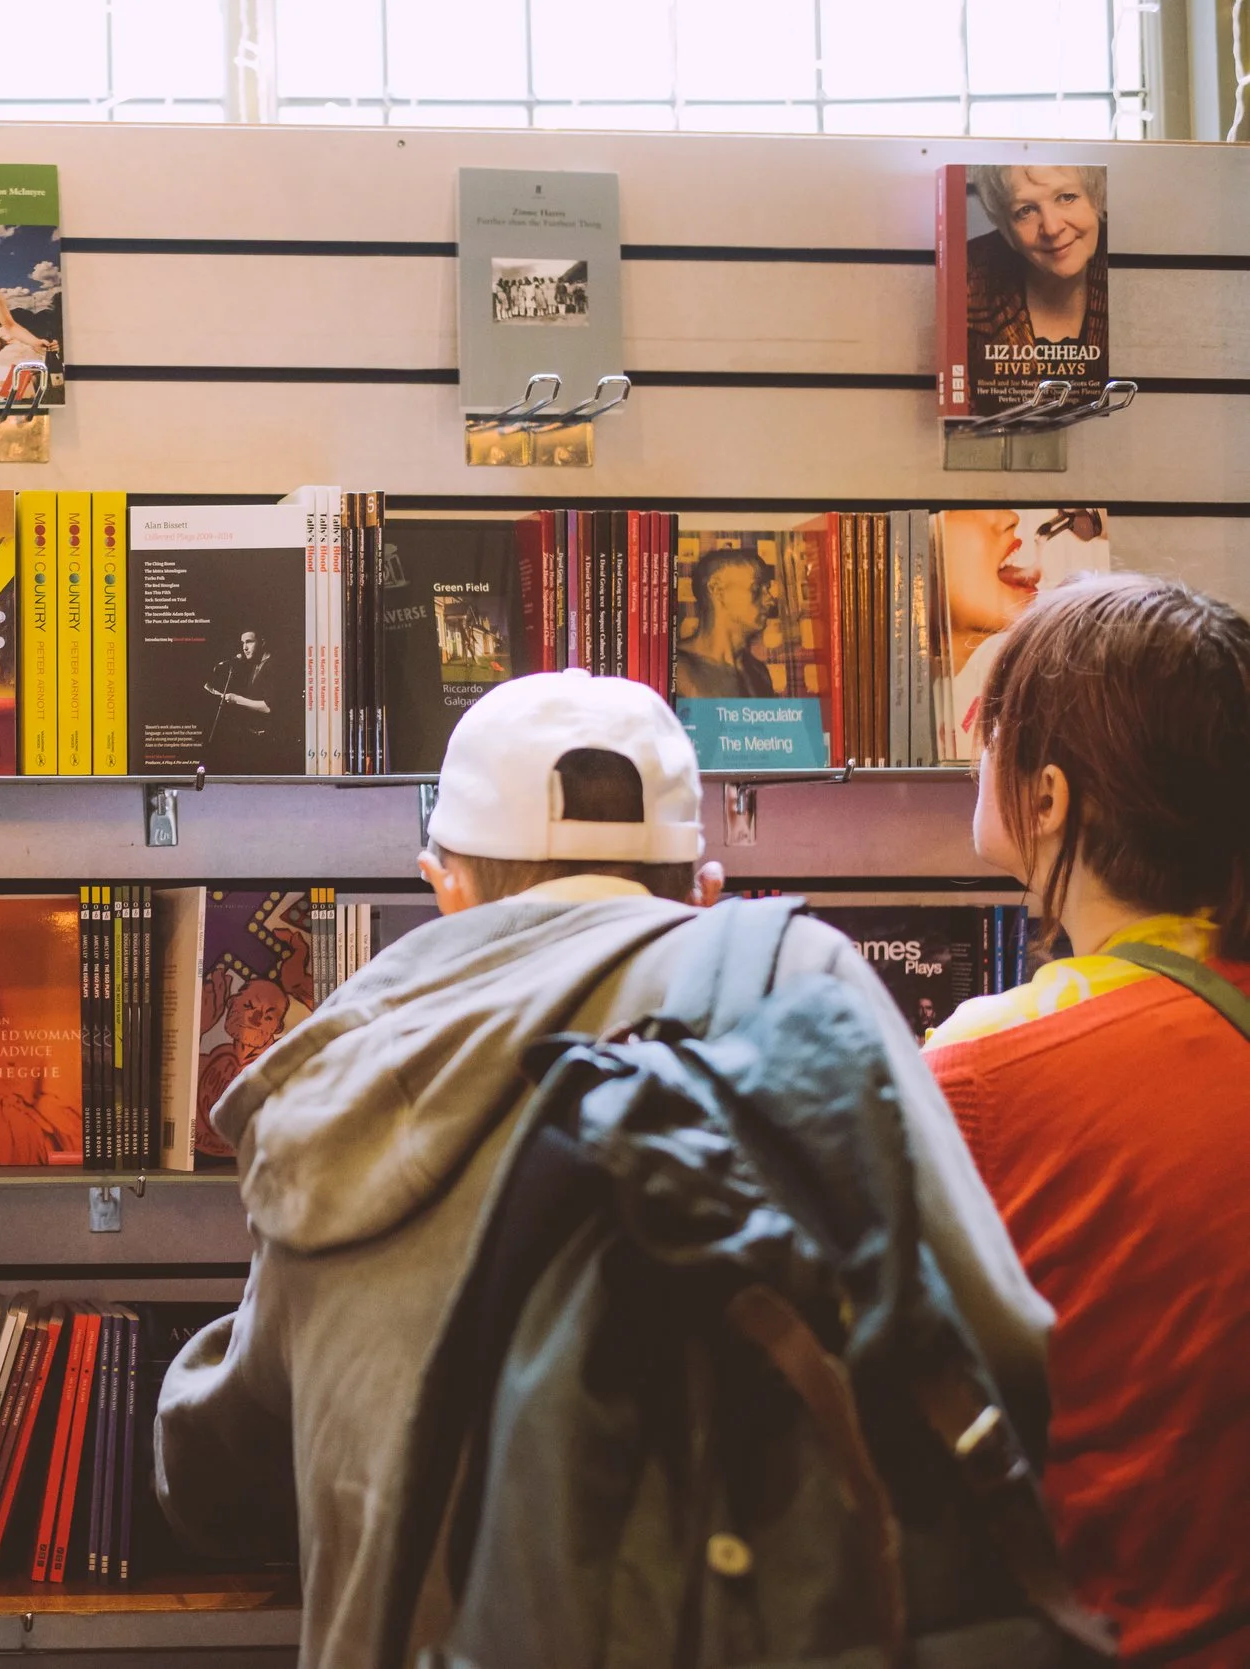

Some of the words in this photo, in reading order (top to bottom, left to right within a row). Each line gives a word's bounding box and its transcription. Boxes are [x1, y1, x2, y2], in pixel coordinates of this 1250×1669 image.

[8, 187, 46, 198] McIntyre
[984, 345, 1009, 360] LIZ
[1013, 345, 1101, 360] LOCHHEAD
[994, 362, 1030, 375] FIVE
[1037, 363, 1086, 375] PLAYS
[34, 513, 46, 556] MOON
[68, 513, 80, 556] MOON
[104, 513, 116, 557] MOON
[306, 513, 314, 543] Tally's
[318, 513, 327, 543] Tally's
[332, 513, 340, 543] Tally's
[306, 545, 314, 572] Blood
[318, 545, 327, 572] Blood
[332, 546, 340, 572] Blood
[34, 562, 46, 632] COUNTRY
[68, 562, 80, 632] COUNTRY
[104, 563, 116, 633] COUNTRY
[433, 583, 463, 592] Green
[466, 583, 489, 592] Field
[37, 641, 45, 675] PETER
[71, 641, 79, 674] PETER
[107, 641, 115, 675] PETER
[37, 679, 45, 720] ARNOTT
[71, 679, 79, 720] ARNOTT
[107, 680, 115, 721] ARNOTT
[443, 684, 483, 693] Riccardo
[444, 697, 480, 707] Galgan
[716, 707, 739, 722] The
[742, 707, 803, 724] Speculator
[718, 736, 741, 751] The
[744, 736, 793, 754] Meeting
[850, 940, 922, 961] ames
[905, 960, 943, 978] Plays
[24, 1030, 81, 1040] WOMAN
[0, 1046, 53, 1057] ADVICE
